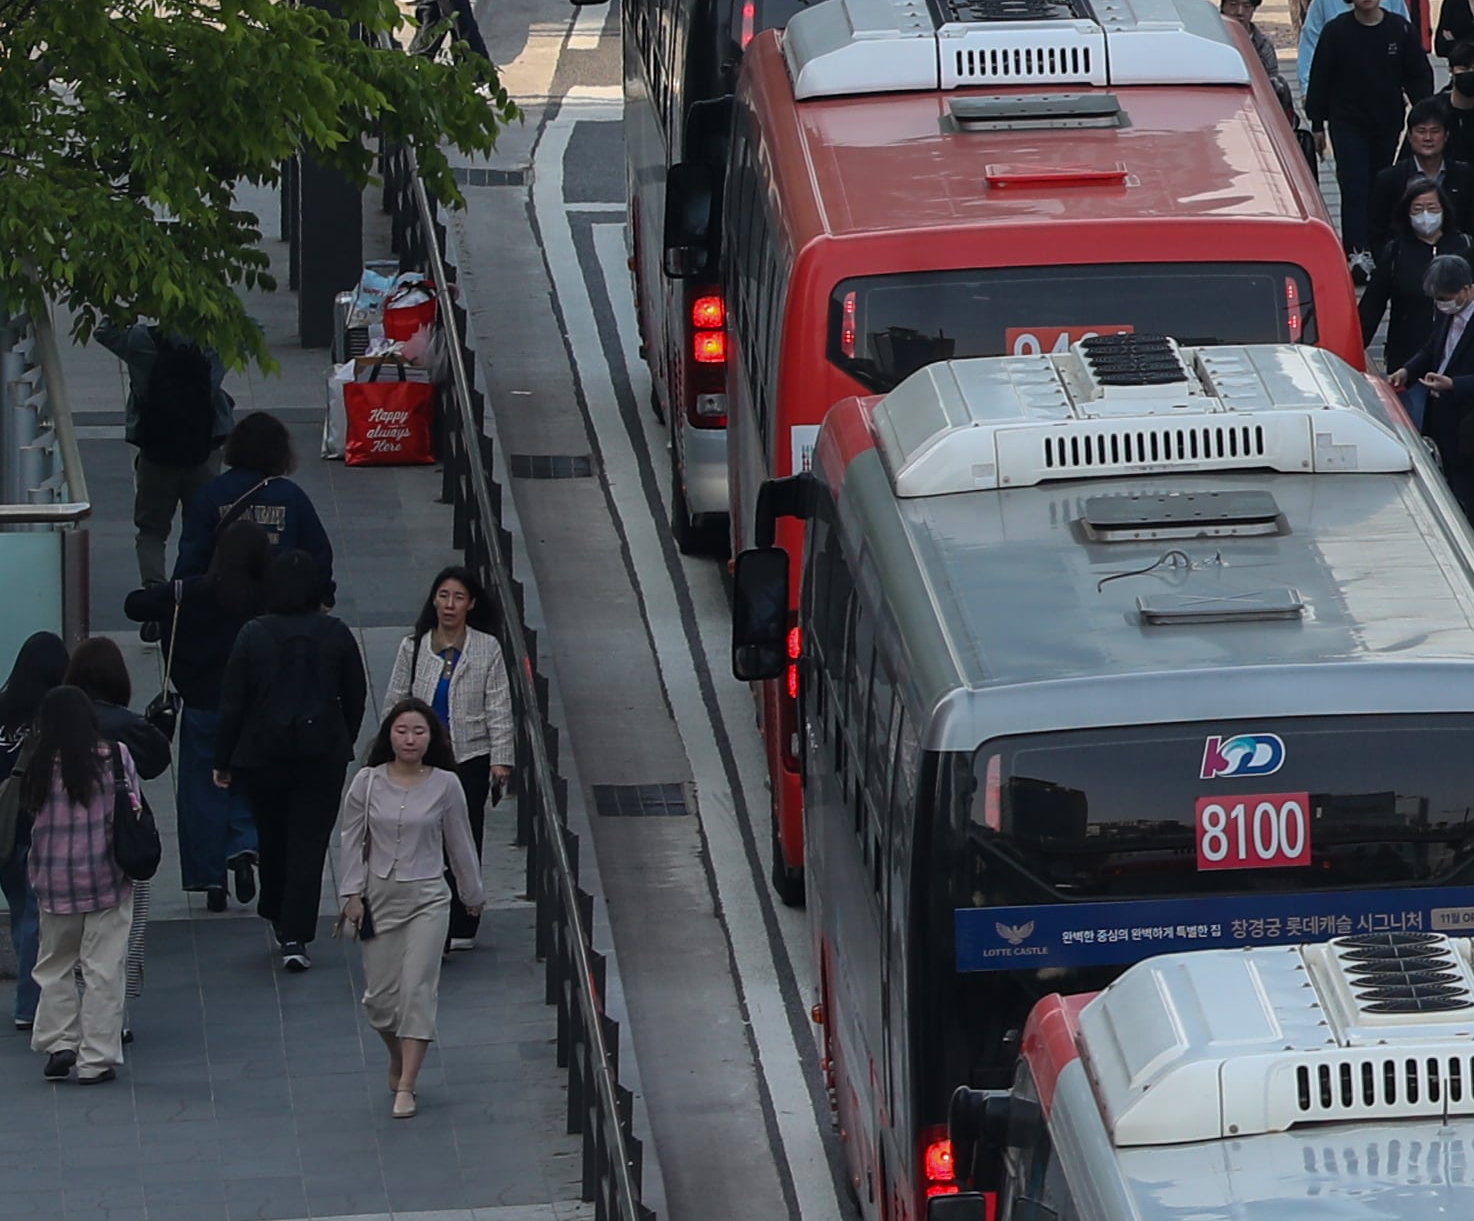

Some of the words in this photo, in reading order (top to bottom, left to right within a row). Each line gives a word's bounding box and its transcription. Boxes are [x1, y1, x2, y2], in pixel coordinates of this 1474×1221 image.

[368, 408, 408, 424] Happy
[366, 424, 411, 441] always
[370, 439, 402, 453] Here
[1201, 800, 1305, 862] 8100
[1231, 917, 1281, 940] 창경궁
[1286, 913, 1353, 936] 롯데캐슬
[1356, 910, 1423, 932] 시그니처
[1440, 913, 1461, 924] 11월
[1062, 929, 1094, 945] 완벽한
[1097, 928, 1129, 943] 중심의
[1131, 926, 1174, 942] 완벽하게
[1176, 925, 1209, 939] 특별한
[1210, 924, 1221, 937] 집
[982, 947, 1013, 957] LOTTE
[1013, 946, 1049, 956] CASTLE
